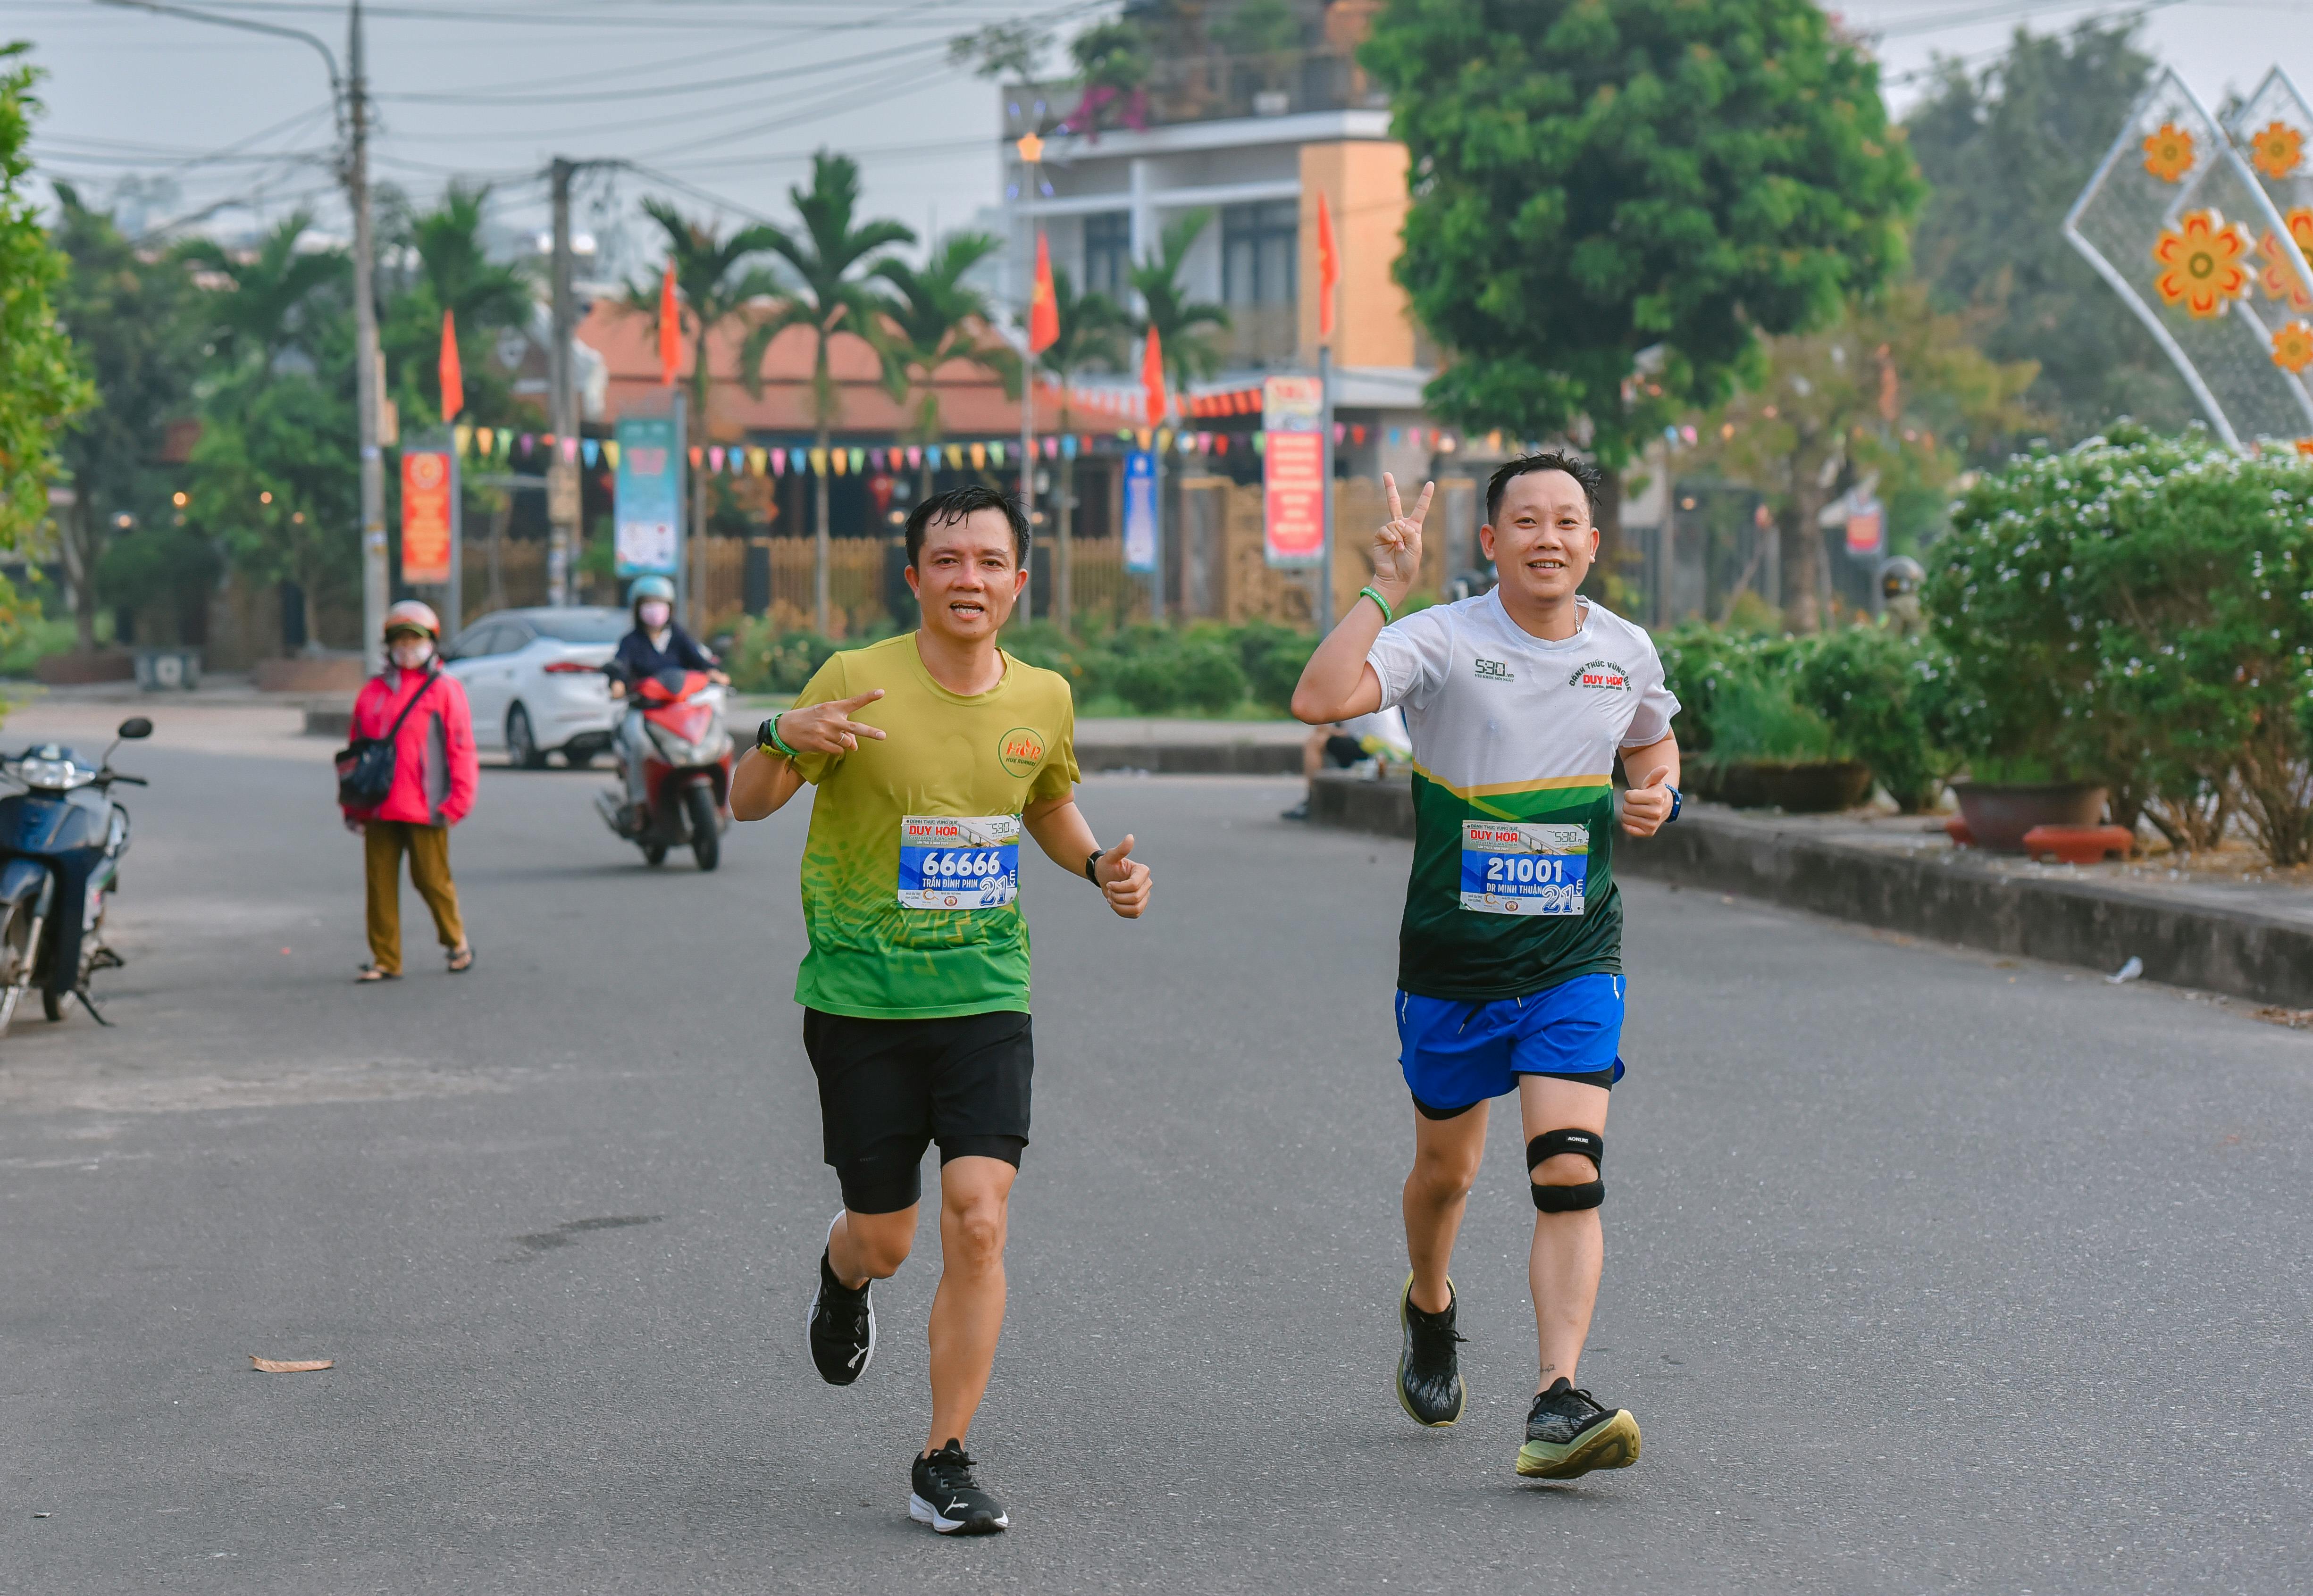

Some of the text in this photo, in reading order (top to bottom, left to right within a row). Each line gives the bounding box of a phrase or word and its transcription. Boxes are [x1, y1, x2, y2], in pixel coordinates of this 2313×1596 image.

[1583, 673, 1623, 686] DUY HÒA
[909, 825, 932, 836] DUY
[1471, 830, 1492, 840] DUY
[922, 851, 1000, 876] 66666
[1487, 857, 1562, 883] 21001
[943, 877, 960, 888] ĐÌNH
[962, 879, 978, 888] PHIN
[979, 876, 1007, 906] 21
[1007, 869, 1016, 887] km
[1487, 883, 1542, 896] DR MINH THUẬN
[1542, 884, 1574, 913] 21
[1574, 879, 1584, 896] km
